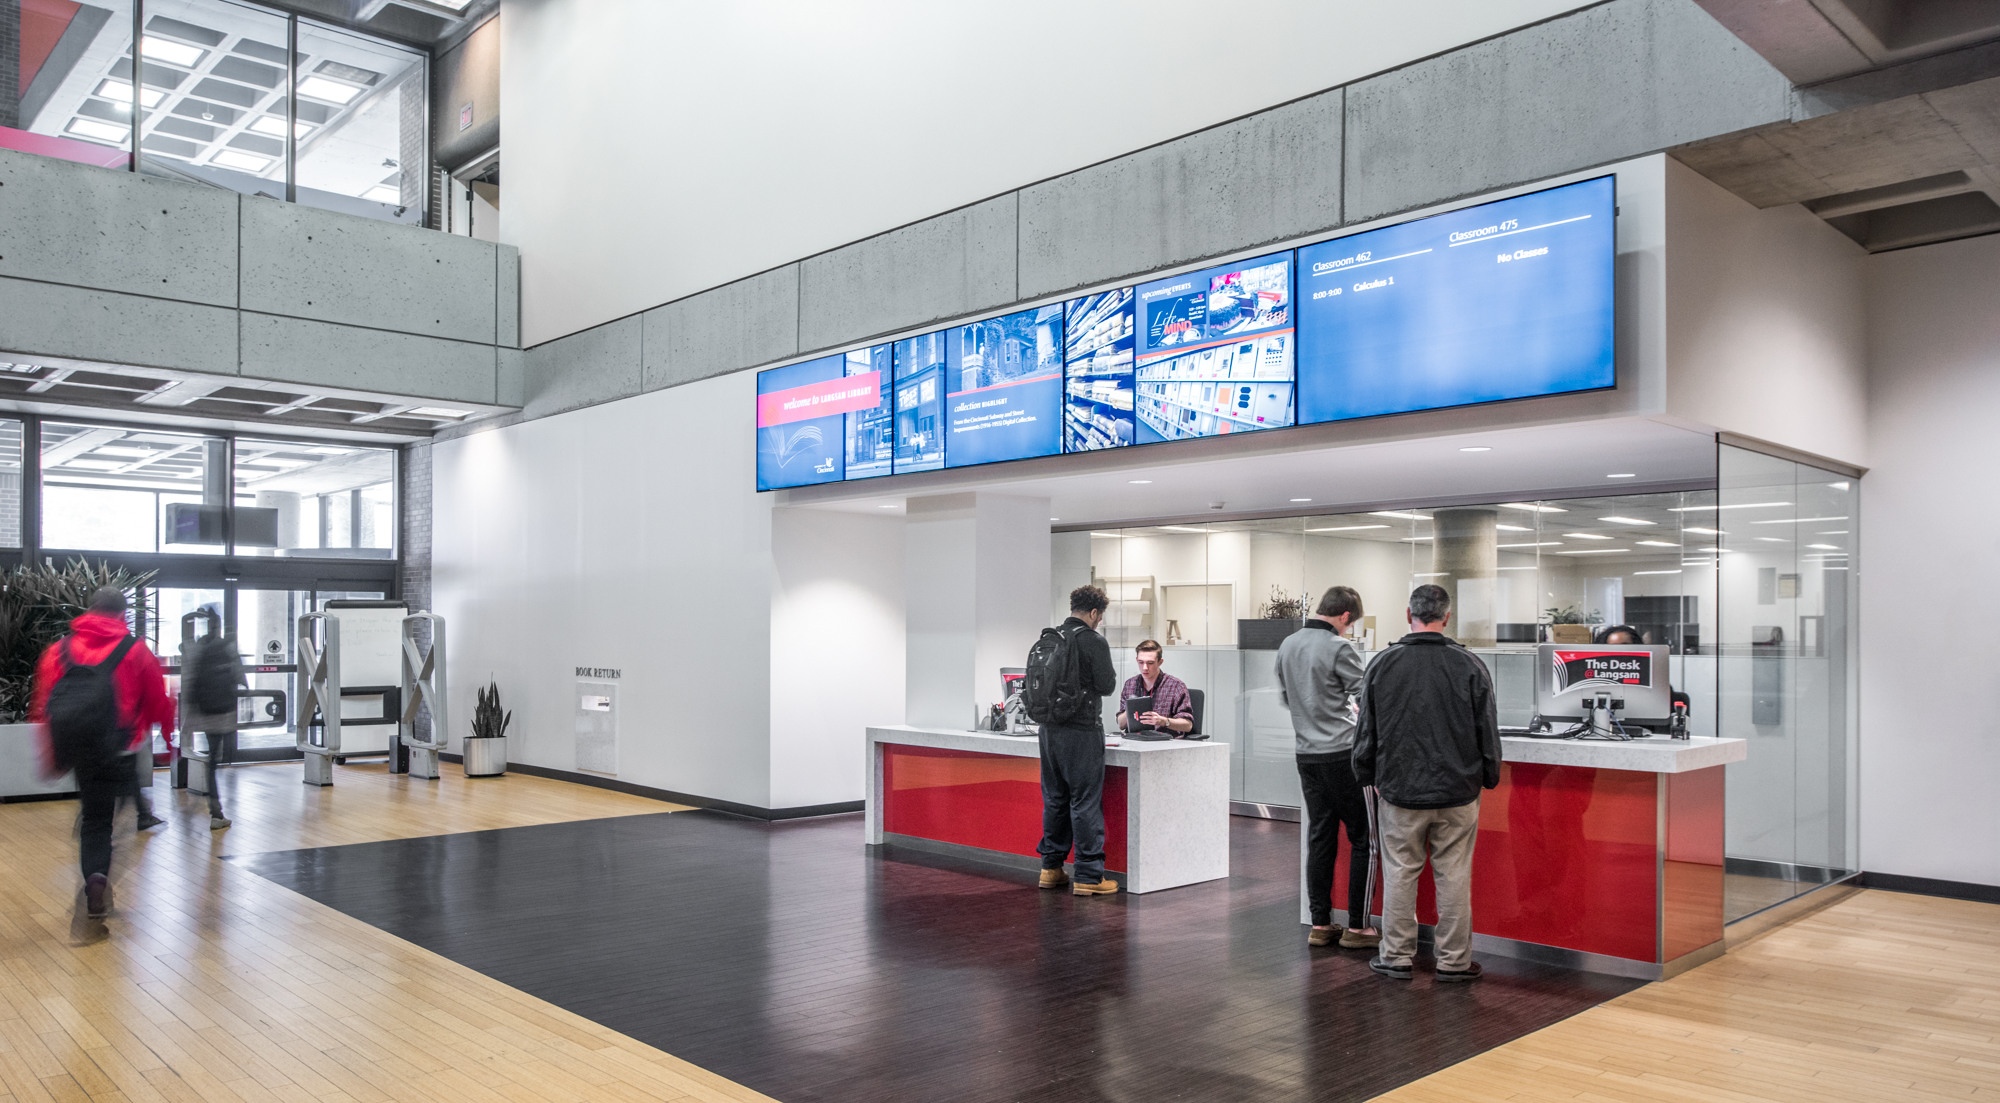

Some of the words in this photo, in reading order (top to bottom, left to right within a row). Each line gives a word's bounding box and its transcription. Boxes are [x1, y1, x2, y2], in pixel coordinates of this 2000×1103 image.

[1449, 225, 1498, 242] Classroom
[1499, 219, 1518, 231] 475
[1313, 257, 1354, 272] Classroom
[1355, 251, 1371, 262] 462
[1497, 254, 1512, 263] No
[1514, 247, 1548, 260] Classes
[1142, 287, 1171, 300] upcoming
[1172, 282, 1191, 292] EVENTS
[1313, 288, 1342, 300] 8:00-9:00
[1353, 279, 1387, 292] Calculus
[1388, 276, 1394, 285] 1
[1164, 320, 1192, 335] MIND
[784, 398, 811, 410] welcome
[812, 395, 819, 405] to
[820, 391, 846, 403] LANGSAM
[848, 386, 871, 398] LIBRARY
[954, 402, 981, 412] collection
[982, 398, 1007, 407] HIGHLIGHT
[1003, 418, 1015, 426] Digital
[1585, 659, 1608, 669] The
[1610, 660, 1640, 670] Desk
[576, 667, 592, 677] BOOK
[594, 668, 621, 679] RETURN
[1585, 669, 1640, 680] @Langsam
